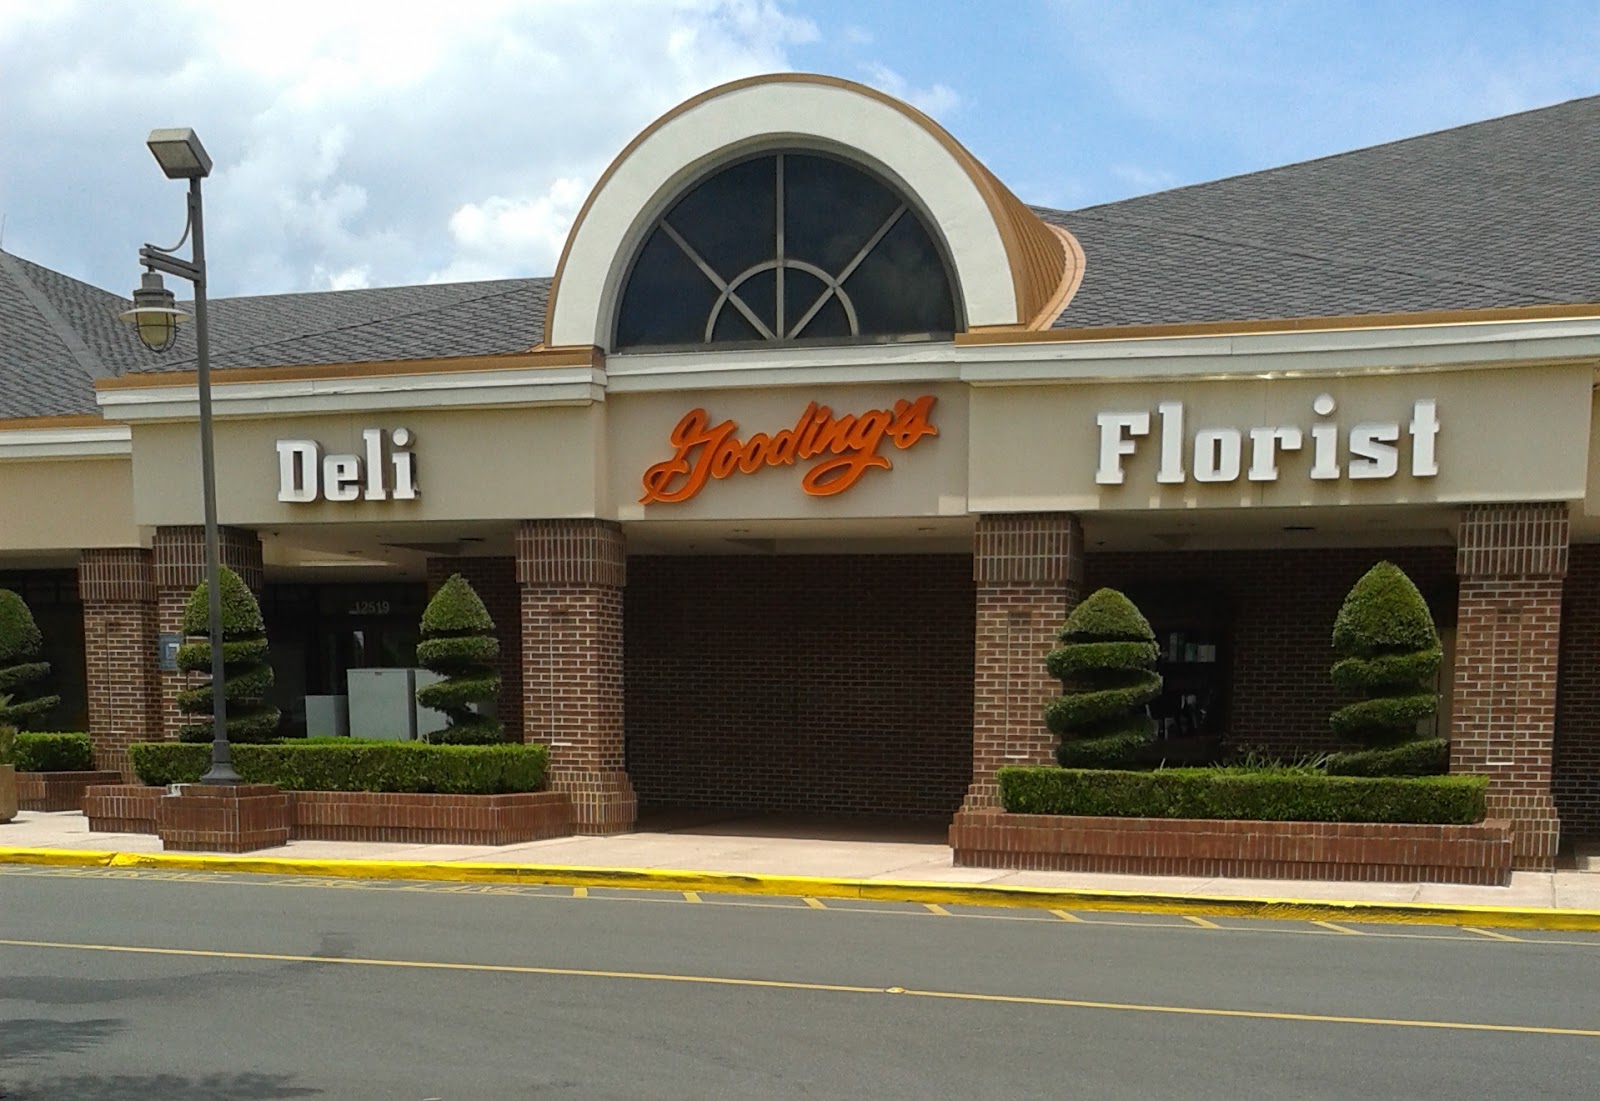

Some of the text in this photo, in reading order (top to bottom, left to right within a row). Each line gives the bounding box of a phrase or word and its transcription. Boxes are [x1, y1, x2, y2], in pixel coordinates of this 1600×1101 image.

[276, 427, 417, 503] Deli
[638, 395, 938, 505] Gooding's
[1096, 393, 1440, 484] Florist
